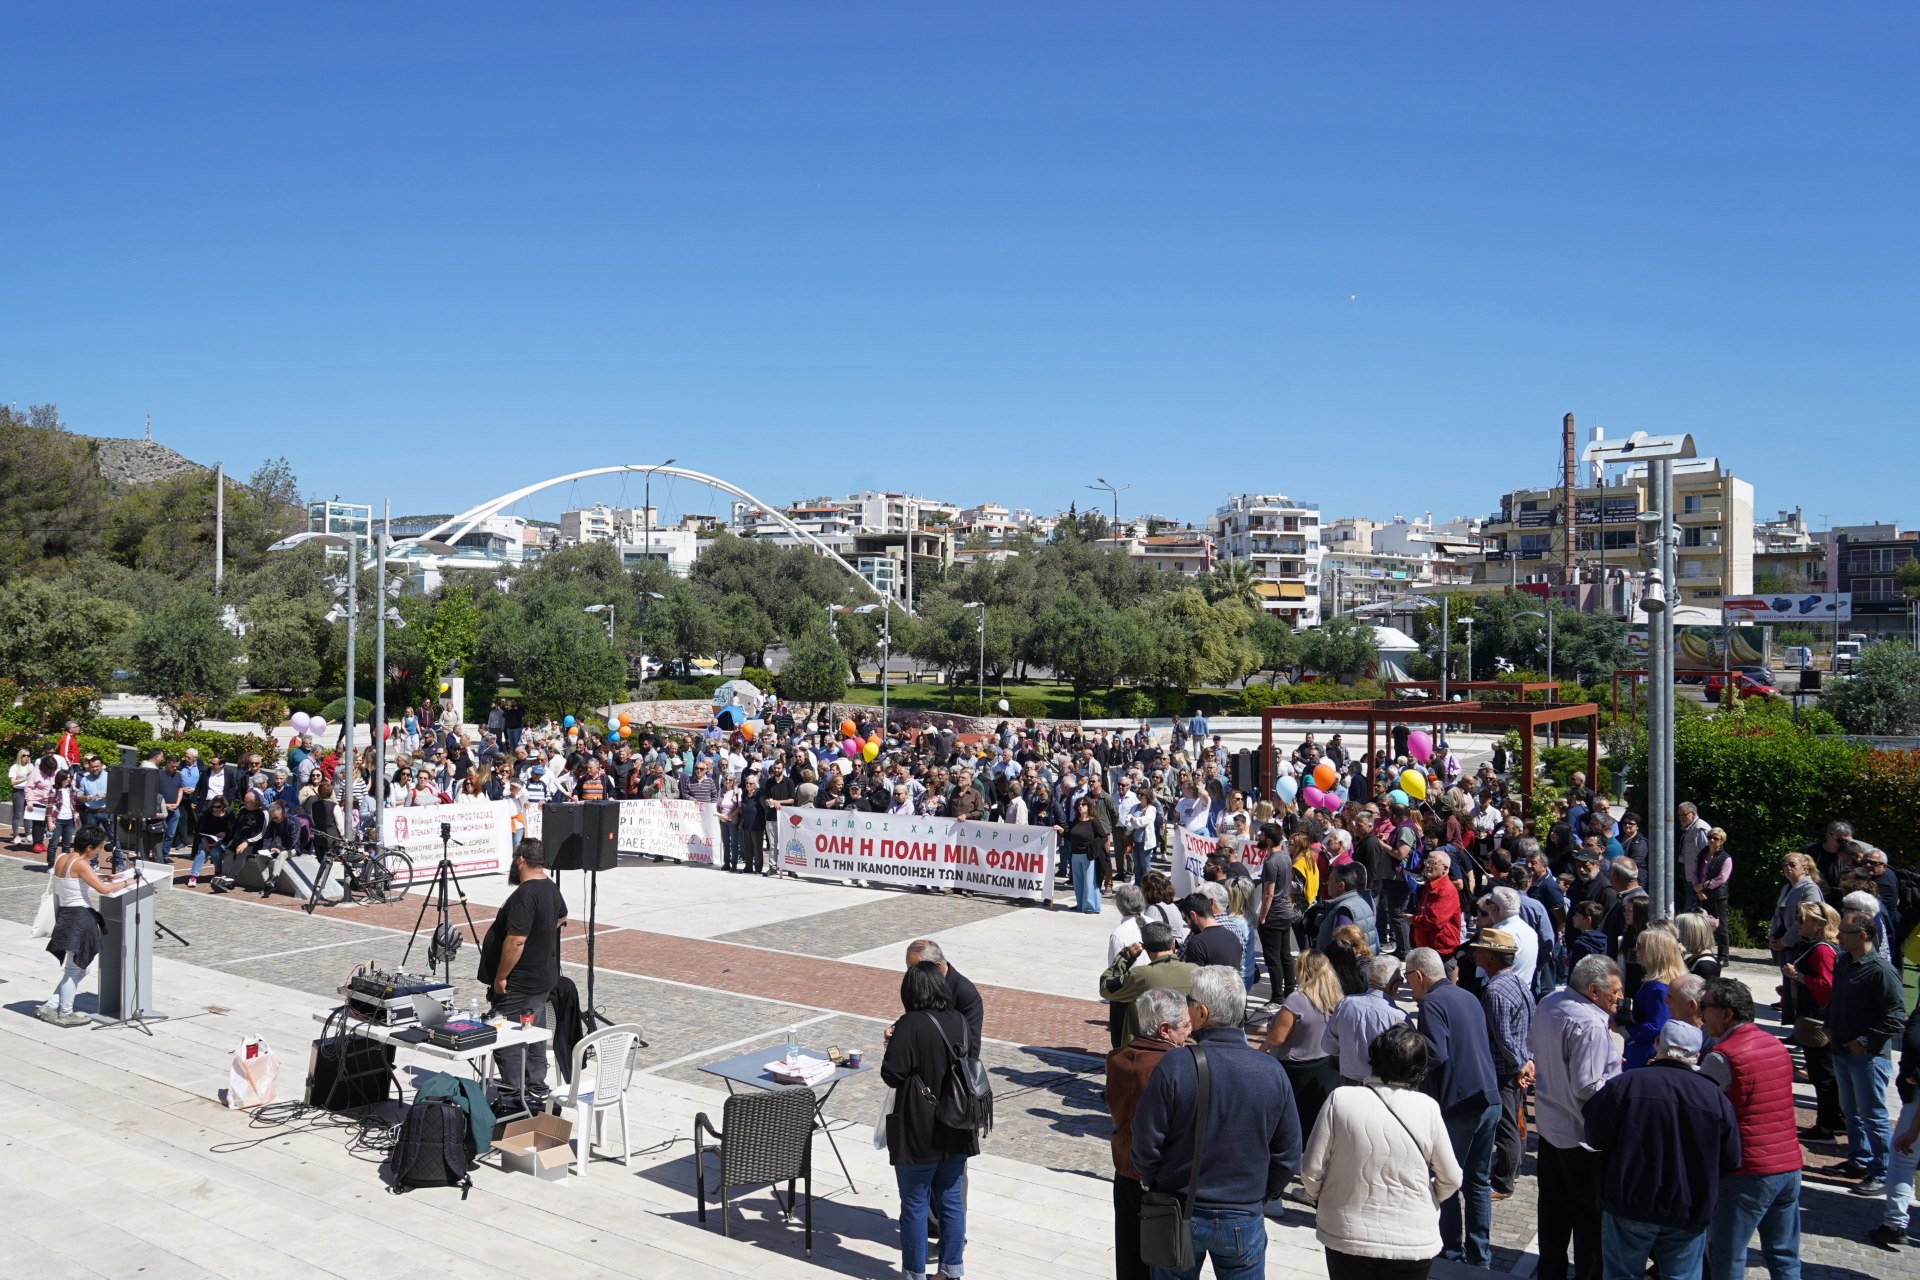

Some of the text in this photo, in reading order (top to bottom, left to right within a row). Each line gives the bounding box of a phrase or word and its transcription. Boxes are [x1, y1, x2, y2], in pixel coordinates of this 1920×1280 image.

[643, 800, 655, 808] ΤΗΣ
[457, 810, 494, 821] ΠΡΟΣΤΑΣΙΑΣ
[639, 807, 679, 819] ΑΙΤΗΜΑΤΑ
[683, 811, 702, 822] ΜΑΣ
[620, 816, 680, 832] ΡΙ ΜΙΑ ΠΟΛΗ
[816, 818, 888, 832] ΔΗΜΟΣ
[620, 826, 653, 837] ΧΡΟΝΕΣ
[659, 831, 697, 845] ΑΝΑΓΚΕΣ
[815, 834, 853, 855] ΟΛΗ
[860, 838, 873, 857] Η
[880, 839, 937, 862] ΠΟΛΗ
[944, 844, 979, 866] ΜΙΑ
[986, 849, 1044, 874] ΦΩΝΗ
[1185, 833, 1268, 865] ΣΥΓΧΡΟΝ ΑΣΦ
[815, 857, 1043, 891] ΓΙΑ ΤΗΝ ΙΚΑΝΟΠΟΙΗΣΗ ΤΩΝ ΑΝΑΓΚΩΝ ΜΑΣ
